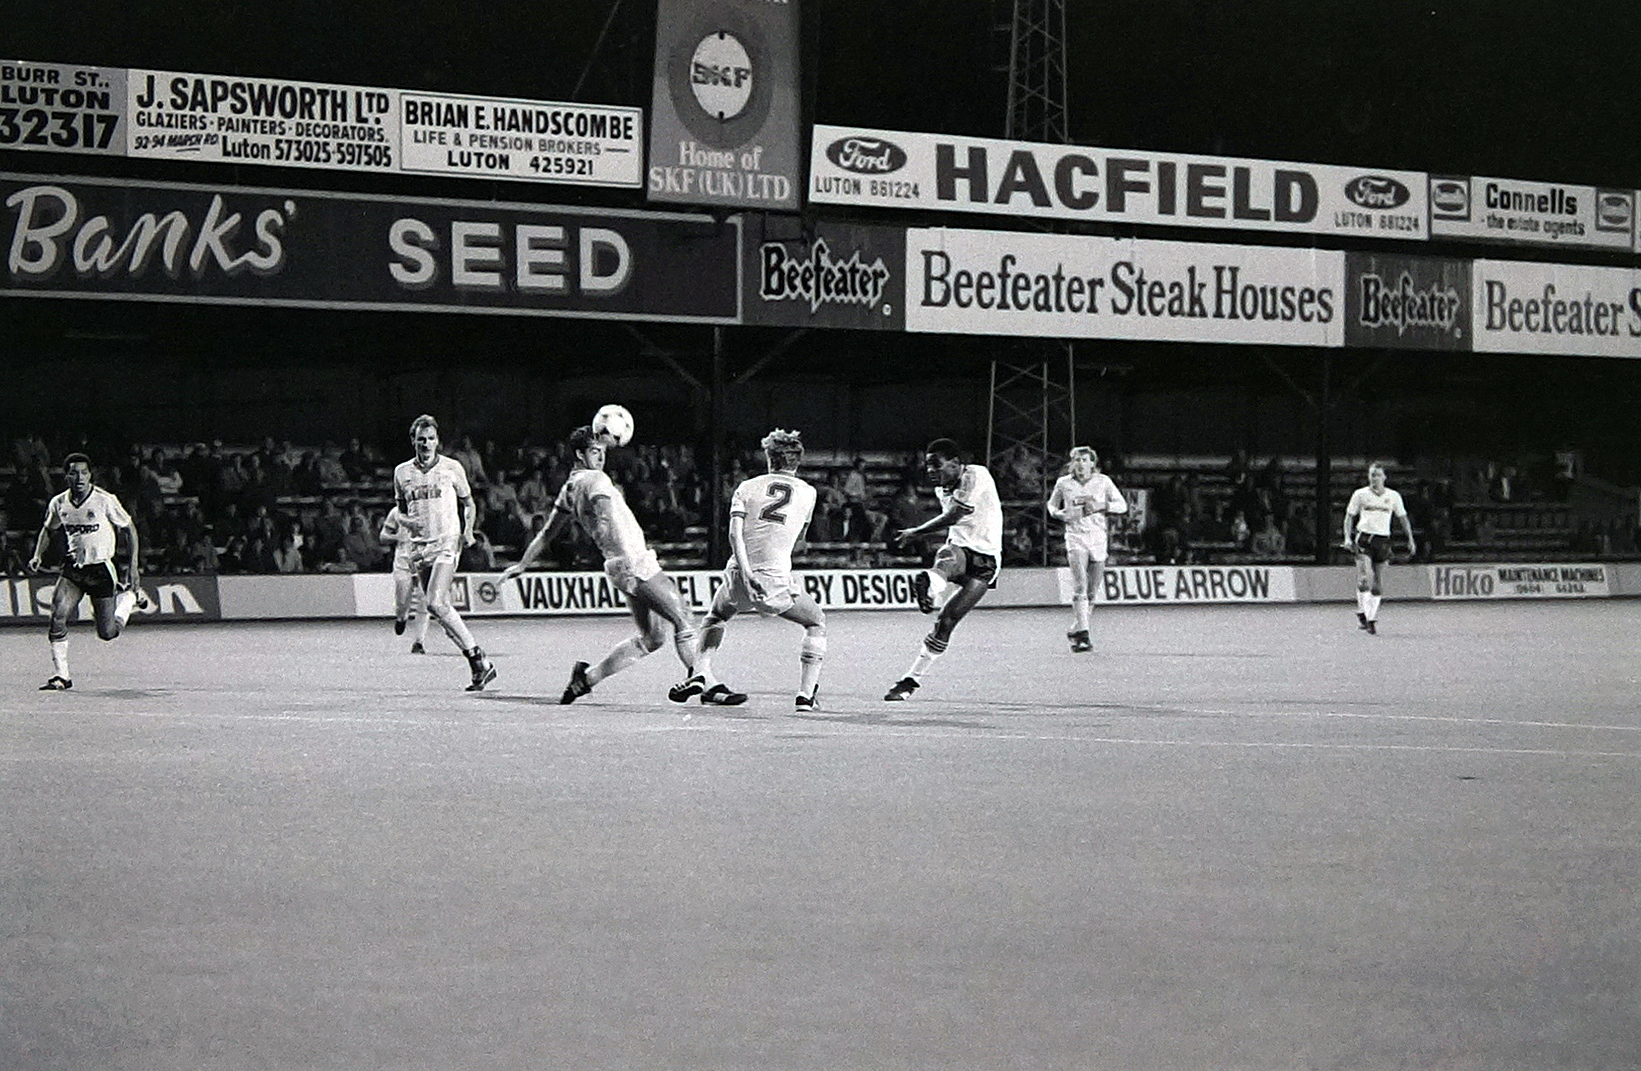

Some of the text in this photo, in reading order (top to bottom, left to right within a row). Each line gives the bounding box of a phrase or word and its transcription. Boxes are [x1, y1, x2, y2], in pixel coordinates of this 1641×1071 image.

[2, 66, 60, 84] BURR
[1, 85, 110, 110] LUTON
[136, 74, 164, 108] J.
[169, 77, 347, 122] SAPSWORTH
[0, 107, 119, 149] 32317
[136, 110, 207, 130] GLAZIERS
[217, 117, 286, 136] PAINTERS
[405, 100, 633, 140] BRIAN E. HANDSCOMBE
[222, 136, 271, 160] Luton
[414, 130, 602, 155] LIFE & PENSION BROKERS
[678, 140, 763, 170] Home of
[839, 139, 893, 171] Ford
[447, 150, 594, 175] LUTON 425921
[814, 175, 861, 195] LUTON
[935, 142, 1320, 224] HACFIELD
[1353, 179, 1396, 206] Ford
[1485, 182, 1578, 215] Connells
[1333, 211, 1373, 229] LUTON
[388, 218, 633, 293] SEED
[760, 237, 890, 312] Beefeater
[921, 249, 1334, 324] Beefeater Steak Houses
[1359, 270, 1460, 336] Beefeater
[1485, 280, 1624, 336] Beefeater
[758, 481, 795, 525] 2
[516, 577, 626, 609] VAUXHAL
[804, 575, 834, 605] BY
[1103, 568, 1269, 600] BLUE ARROW
